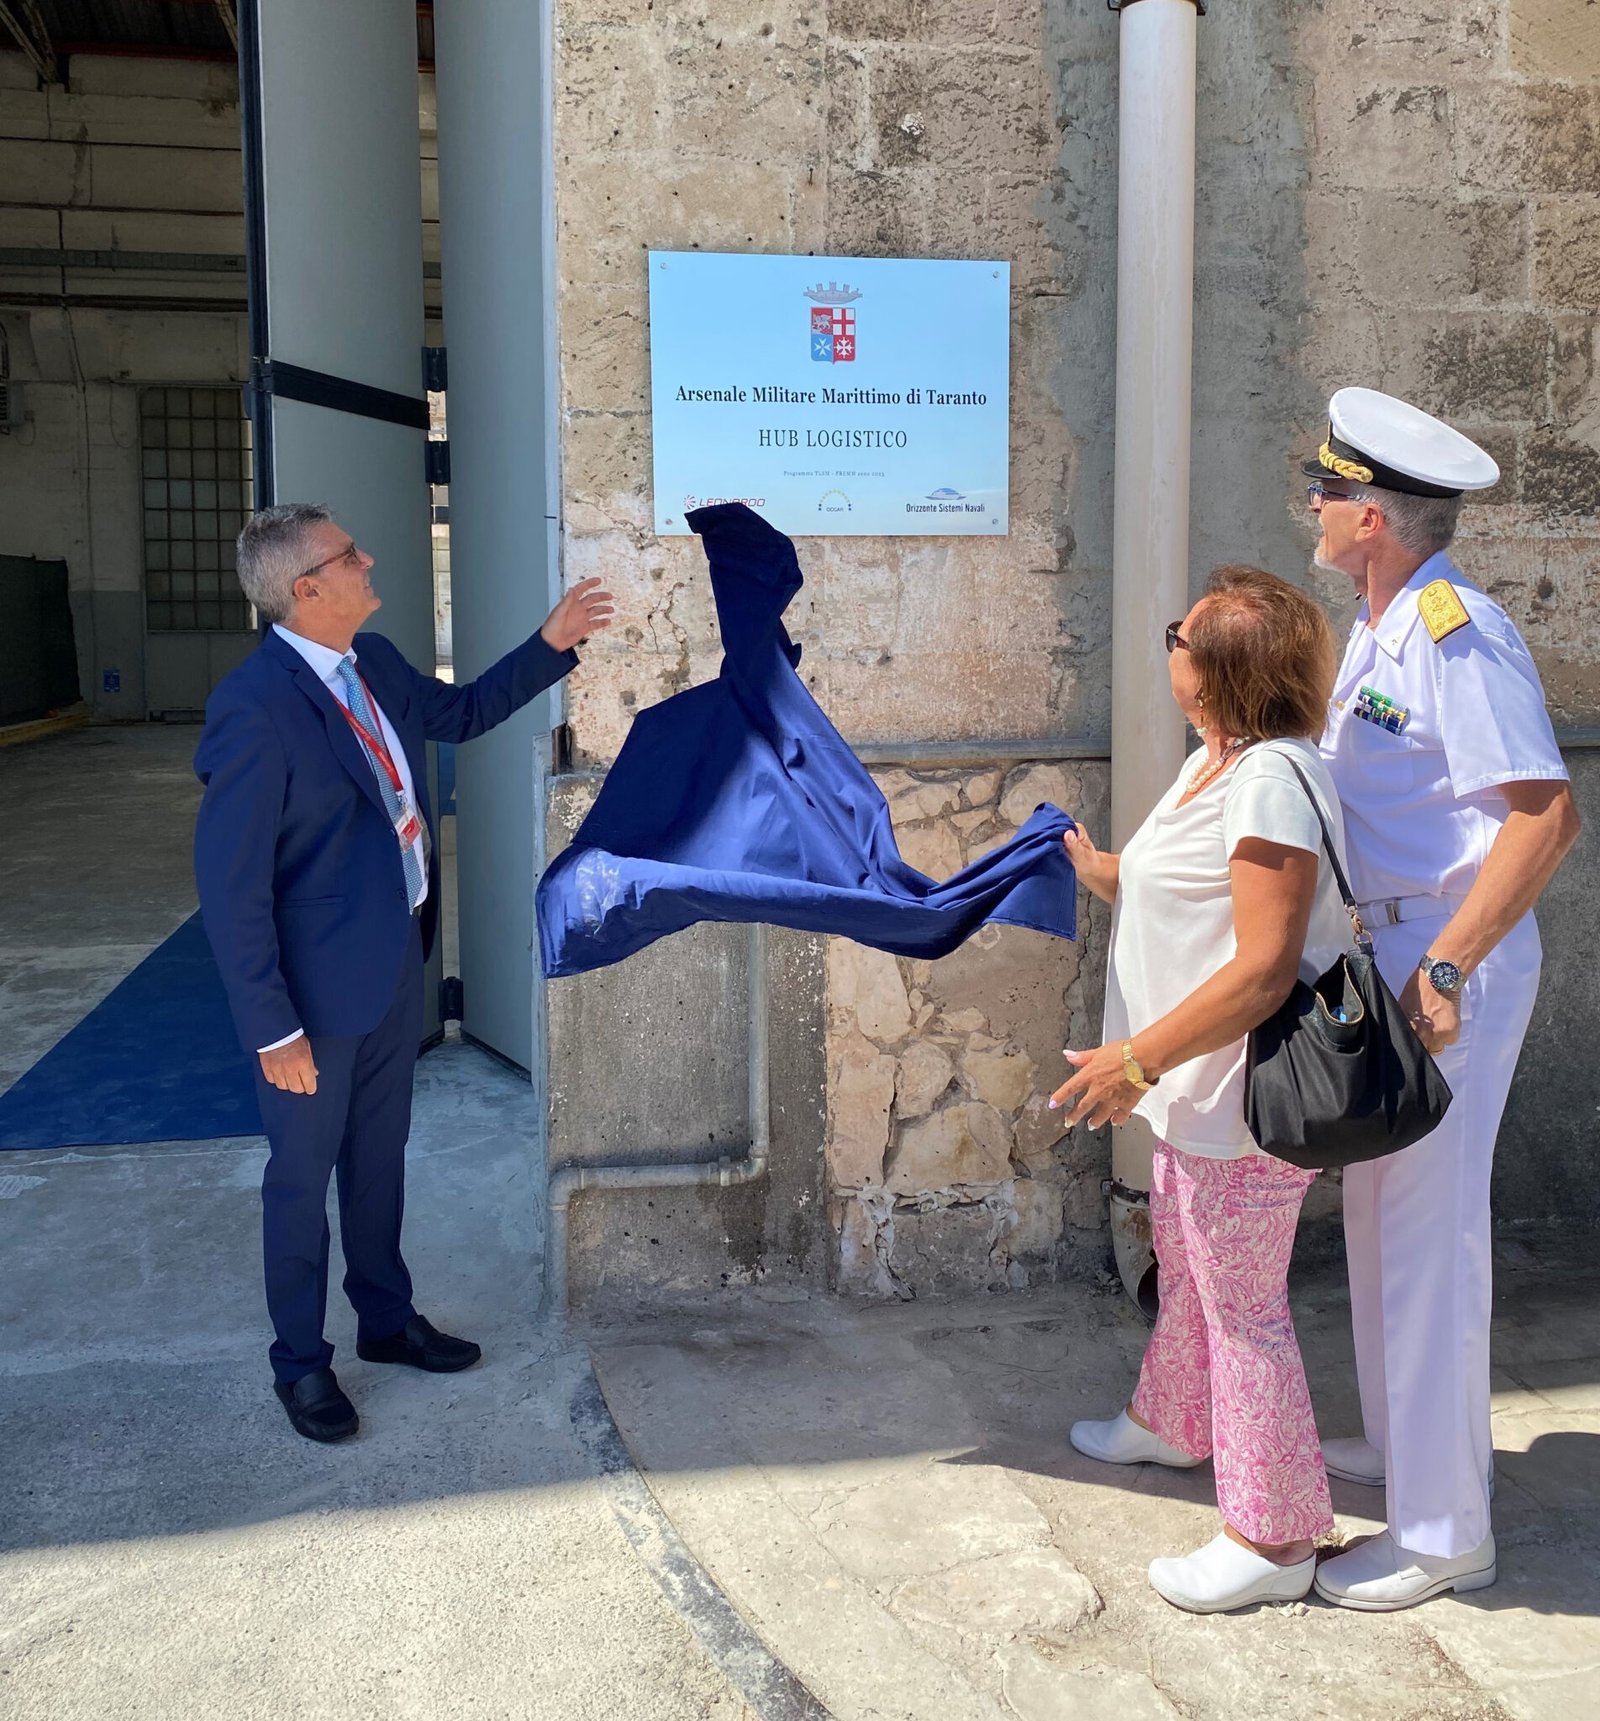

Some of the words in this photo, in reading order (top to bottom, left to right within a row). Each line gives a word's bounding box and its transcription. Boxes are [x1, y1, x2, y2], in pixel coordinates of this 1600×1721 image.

[675, 385, 747, 402] Arsenale
[752, 386, 816, 404] Militare
[821, 387, 901, 405] Marittimo
[906, 388, 921, 405] di
[926, 389, 987, 406] Taranto
[759, 429, 799, 447] HUB
[806, 429, 907, 448] LOGISTICO
[906, 503, 937, 513] Orizzonte
[938, 503, 964, 513] Sistemi
[965, 503, 986, 513] Navali
